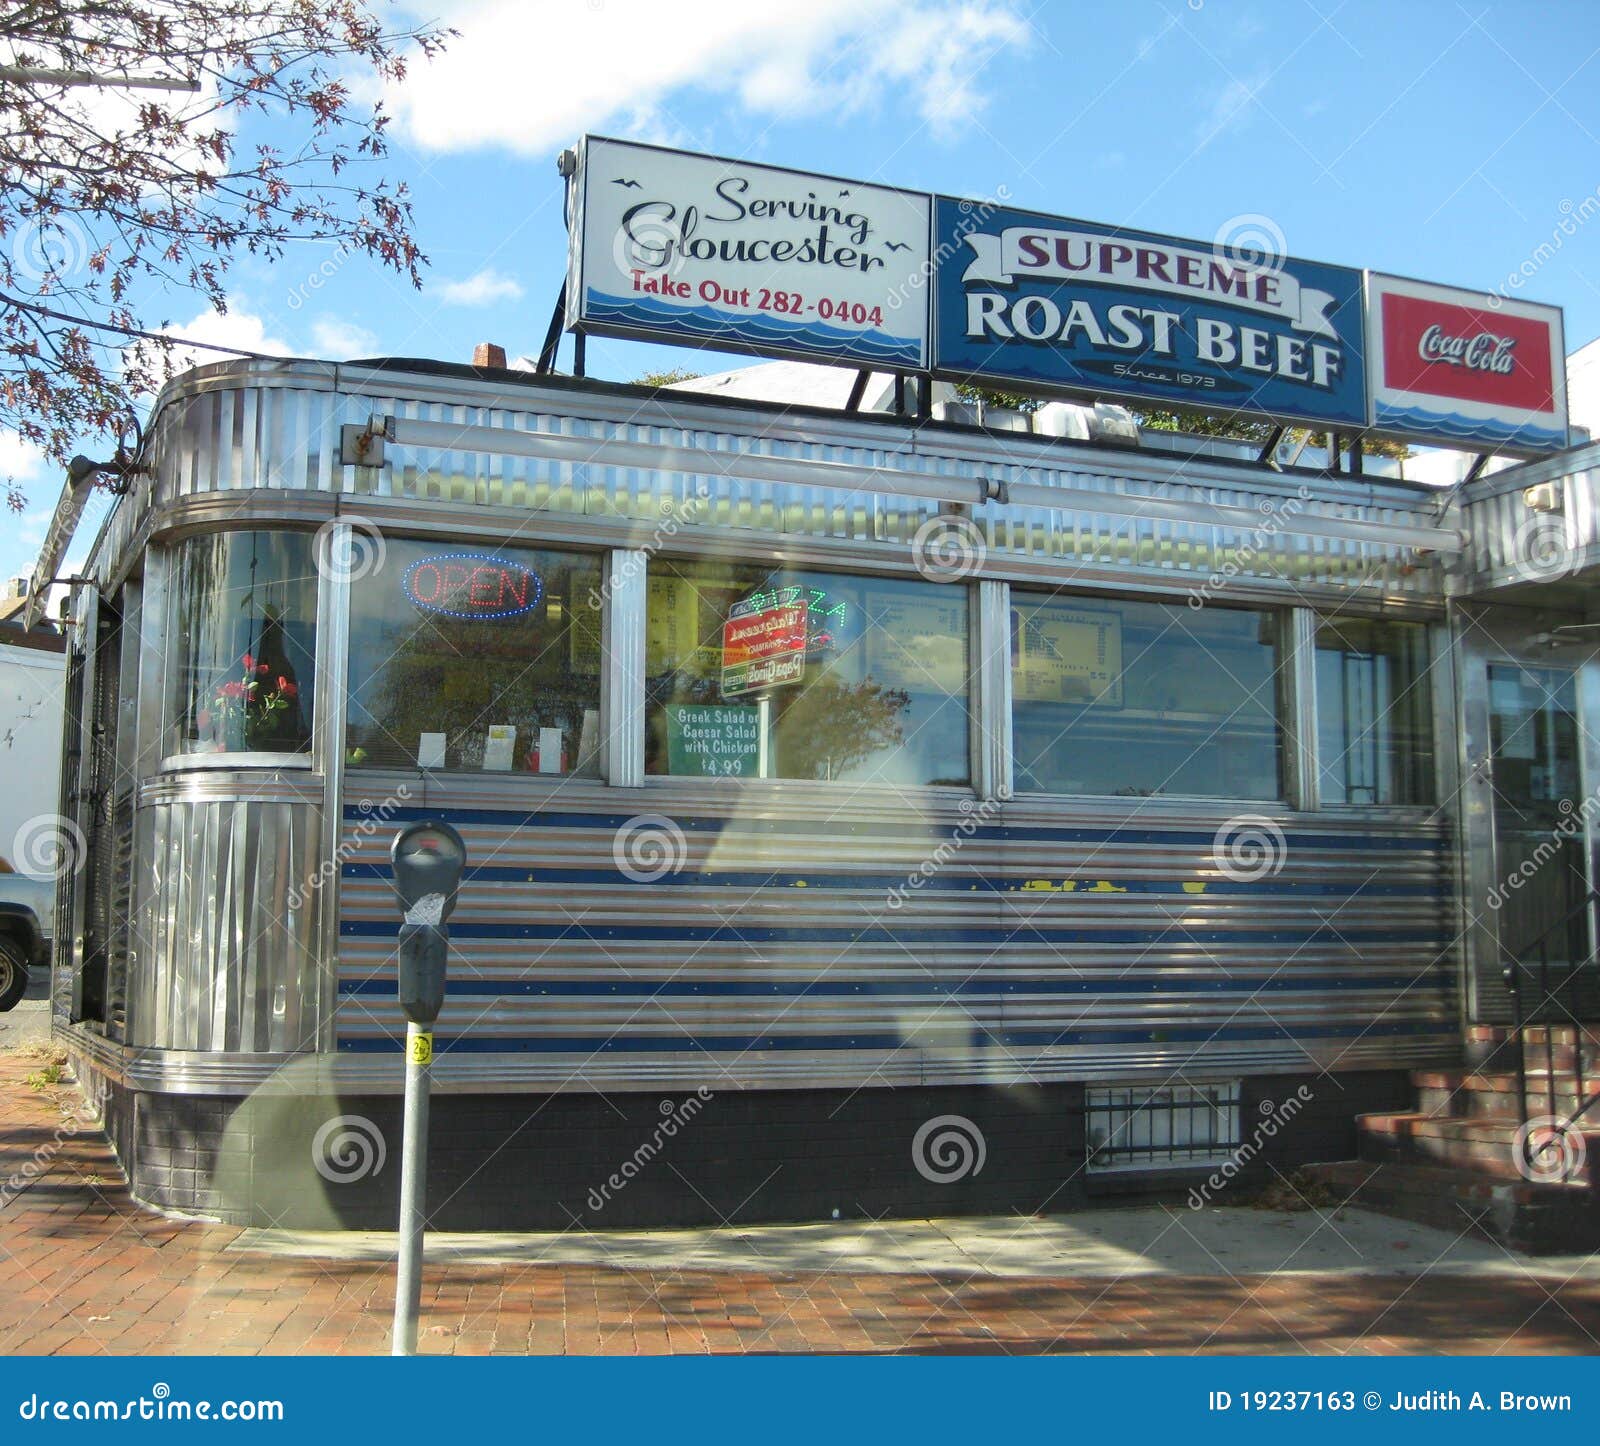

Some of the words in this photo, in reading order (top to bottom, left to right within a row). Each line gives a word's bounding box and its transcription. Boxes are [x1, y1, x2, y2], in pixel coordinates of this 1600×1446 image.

[704, 177, 874, 245] Serving
[621, 200, 884, 273] Gloucester
[1017, 235, 1282, 308] SUPREME
[630, 268, 692, 298] Take
[699, 279, 750, 308] Out
[758, 287, 884, 327] 282-0404
[966, 293, 1180, 355] ROAST
[1196, 318, 1341, 388] BEEF
[1113, 364, 1172, 381] Since
[1176, 372, 1216, 388] 1973
[412, 564, 529, 607] OPEN
[749, 587, 849, 627] PIZZA
[678, 708, 711, 724] Greek
[714, 710, 745, 724] Salad
[683, 725, 721, 738] Caesar
[726, 725, 757, 738] Salad
[684, 740, 709, 753] with
[713, 739, 757, 754] Chicken
